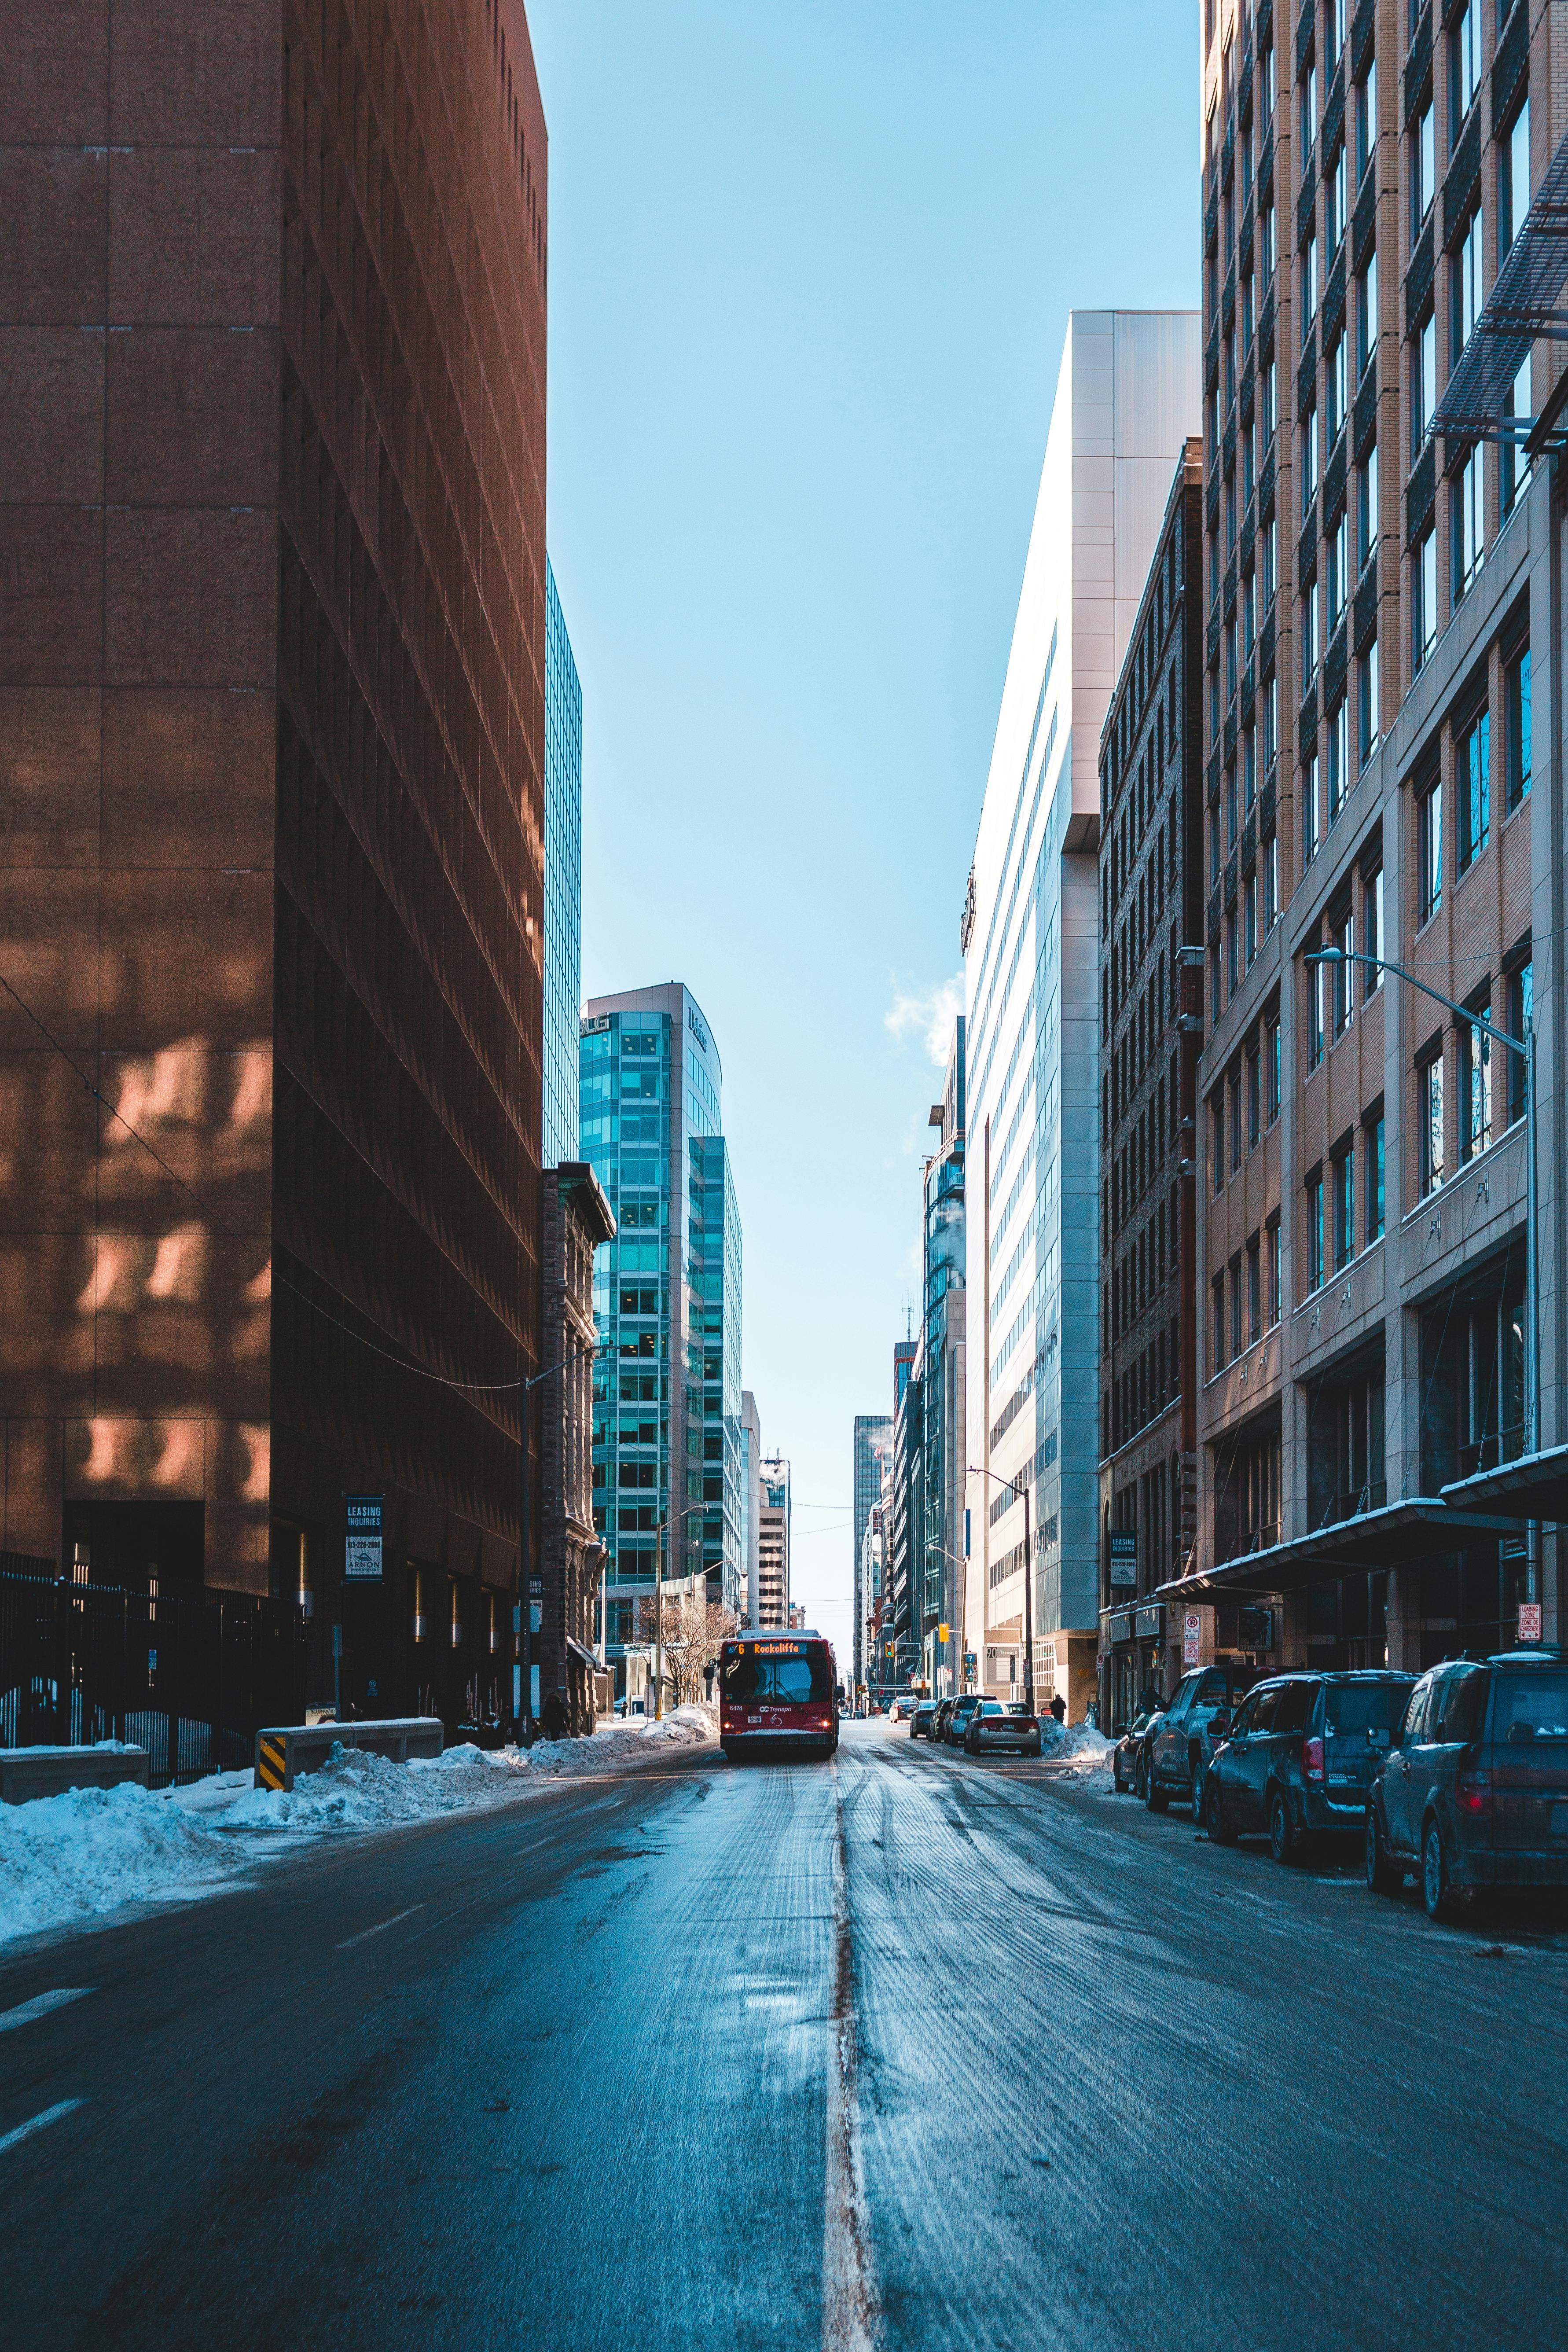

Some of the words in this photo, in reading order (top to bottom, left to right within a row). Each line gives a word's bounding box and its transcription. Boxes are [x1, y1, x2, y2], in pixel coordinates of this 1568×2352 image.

[348, 1507, 381, 1516] LEASING
[348, 1518, 380, 1526] INQUIRIES
[738, 1644, 744, 1654] 6
[754, 1643, 799, 1654] Rockcliffe
[987, 1647, 997, 1659] 90
